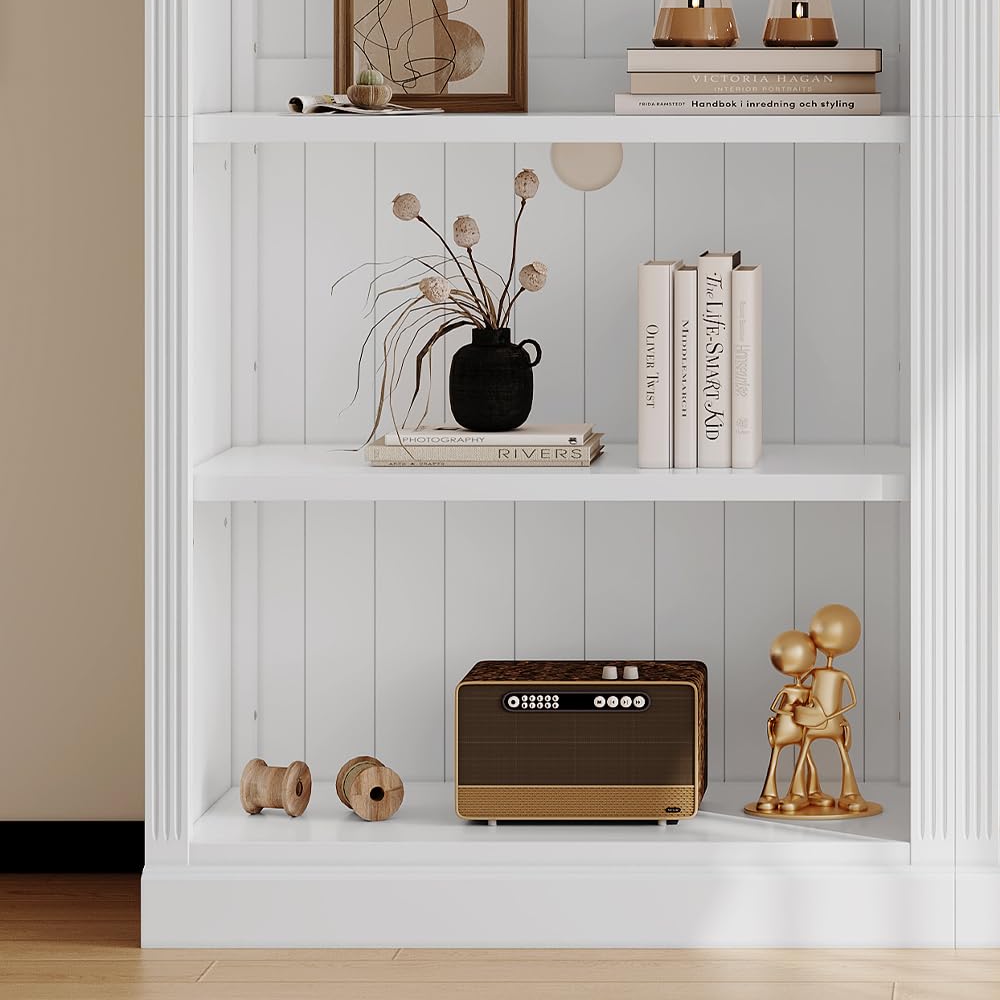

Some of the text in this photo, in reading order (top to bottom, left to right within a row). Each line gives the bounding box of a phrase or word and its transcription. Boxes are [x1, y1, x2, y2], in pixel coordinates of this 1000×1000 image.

[691, 100, 737, 108] Handbok
[746, 100, 796, 110] inredning
[800, 100, 817, 108] och
[821, 100, 855, 110] styling
[646, 324, 659, 408] OLIVER TWIST
[498, 448, 582, 459] RIVERS
